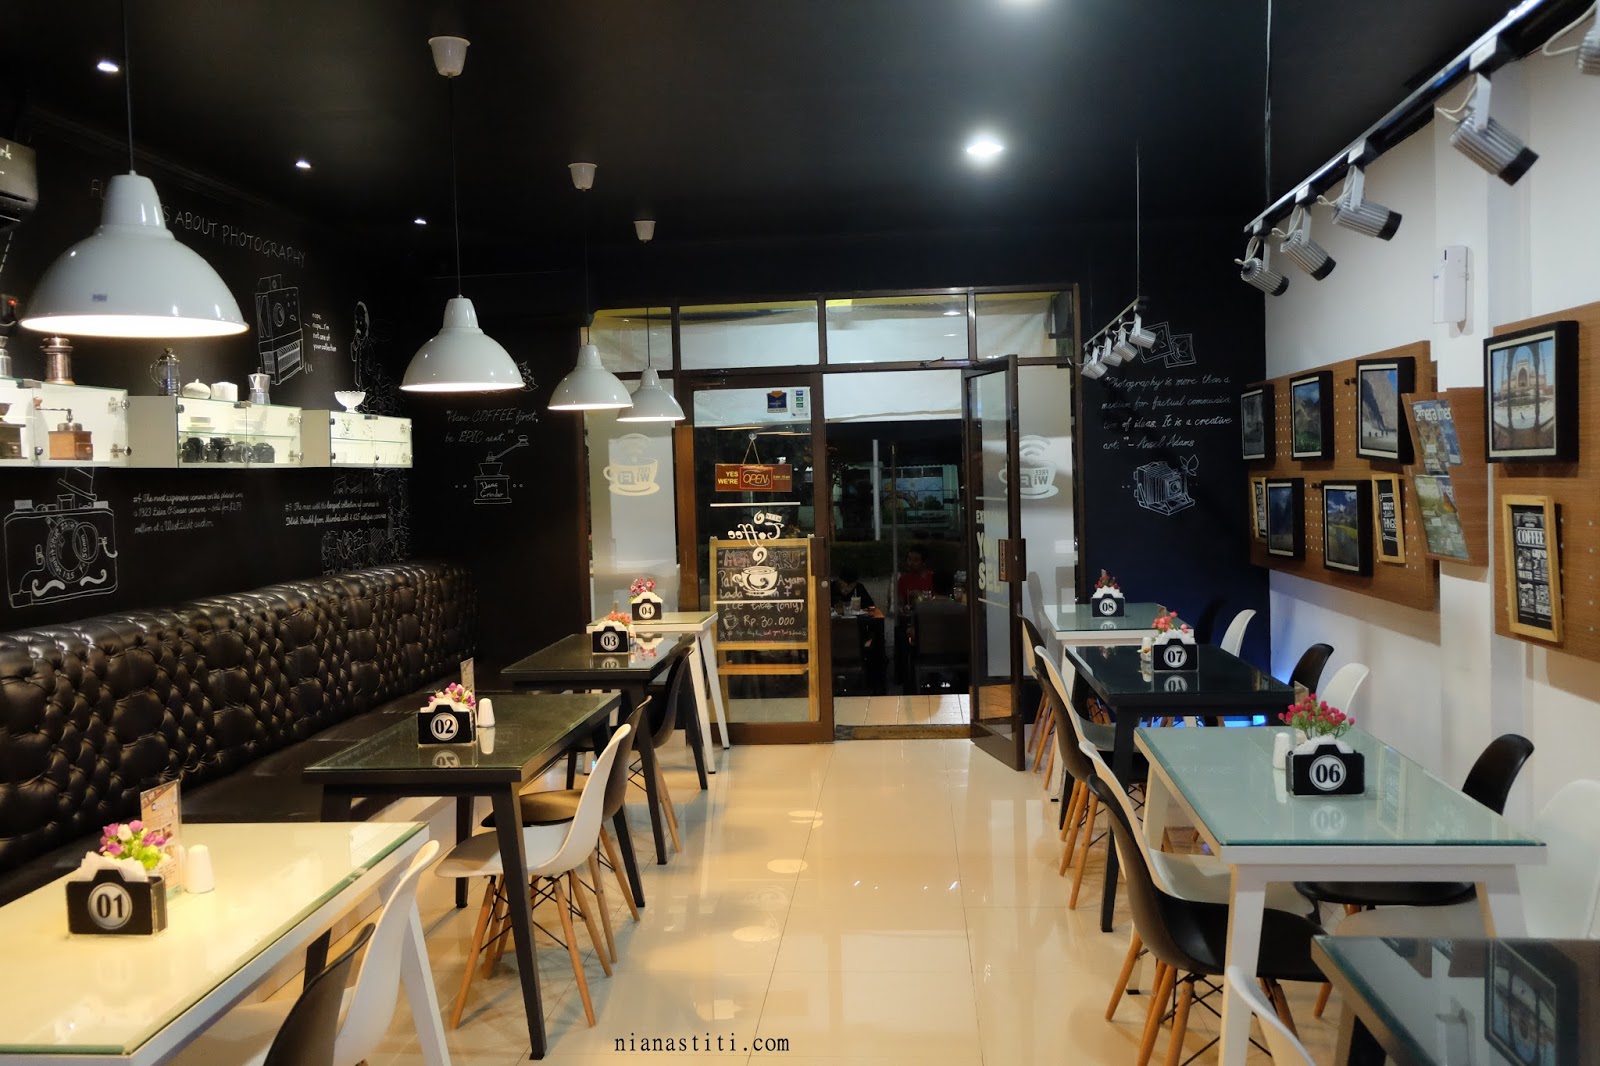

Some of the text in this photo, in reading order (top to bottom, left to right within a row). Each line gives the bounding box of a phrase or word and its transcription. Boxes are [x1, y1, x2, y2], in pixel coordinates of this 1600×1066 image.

[175, 211, 218, 238] ABOUT
[222, 225, 306, 268] PHOTOGRAPHY
[1175, 378, 1198, 387] more
[1202, 374, 1221, 384] than
[1134, 396, 1149, 411] for
[1152, 394, 1187, 410] factual
[472, 407, 517, 423] COFFEE
[1122, 416, 1133, 432] of
[1161, 414, 1172, 428] It
[1194, 416, 1233, 426] creative
[458, 429, 484, 444] EPIC
[1166, 433, 1195, 447] Adams
[743, 473, 769, 484] OPEN
[1517, 528, 1544, 545] COFFEE
[777, 574, 806, 589] Ayam
[641, 606, 653, 615] 04
[1102, 602, 1114, 612] 08
[743, 614, 759, 627] Rp.
[603, 635, 617, 647] 03
[1167, 650, 1183, 663] 07
[434, 718, 454, 735] 02
[1315, 763, 1341, 783] 06
[96, 893, 123, 919] 01
